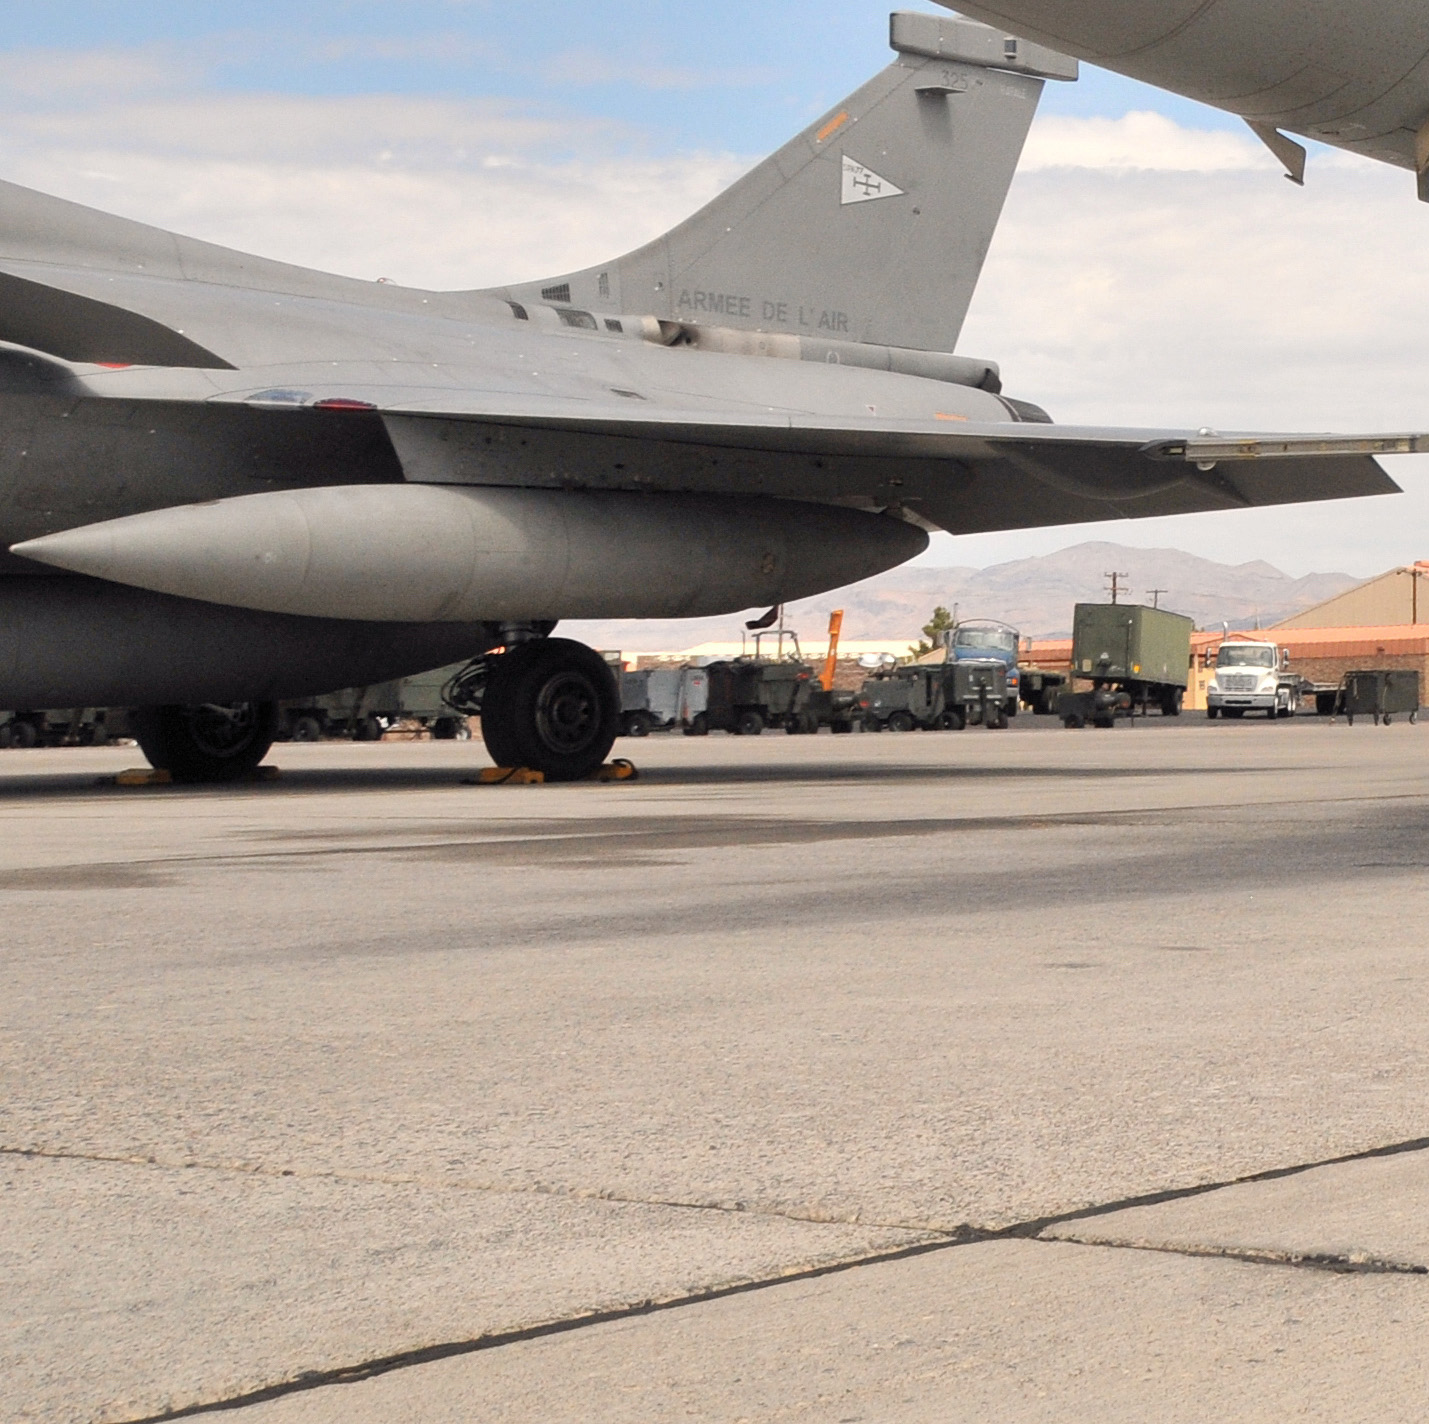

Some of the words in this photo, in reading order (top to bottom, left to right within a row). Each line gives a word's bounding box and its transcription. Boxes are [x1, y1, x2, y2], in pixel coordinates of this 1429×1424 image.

[941, 69, 969, 90] 325
[677, 288, 751, 318] ARMEE
[762, 300, 788, 323] DE
